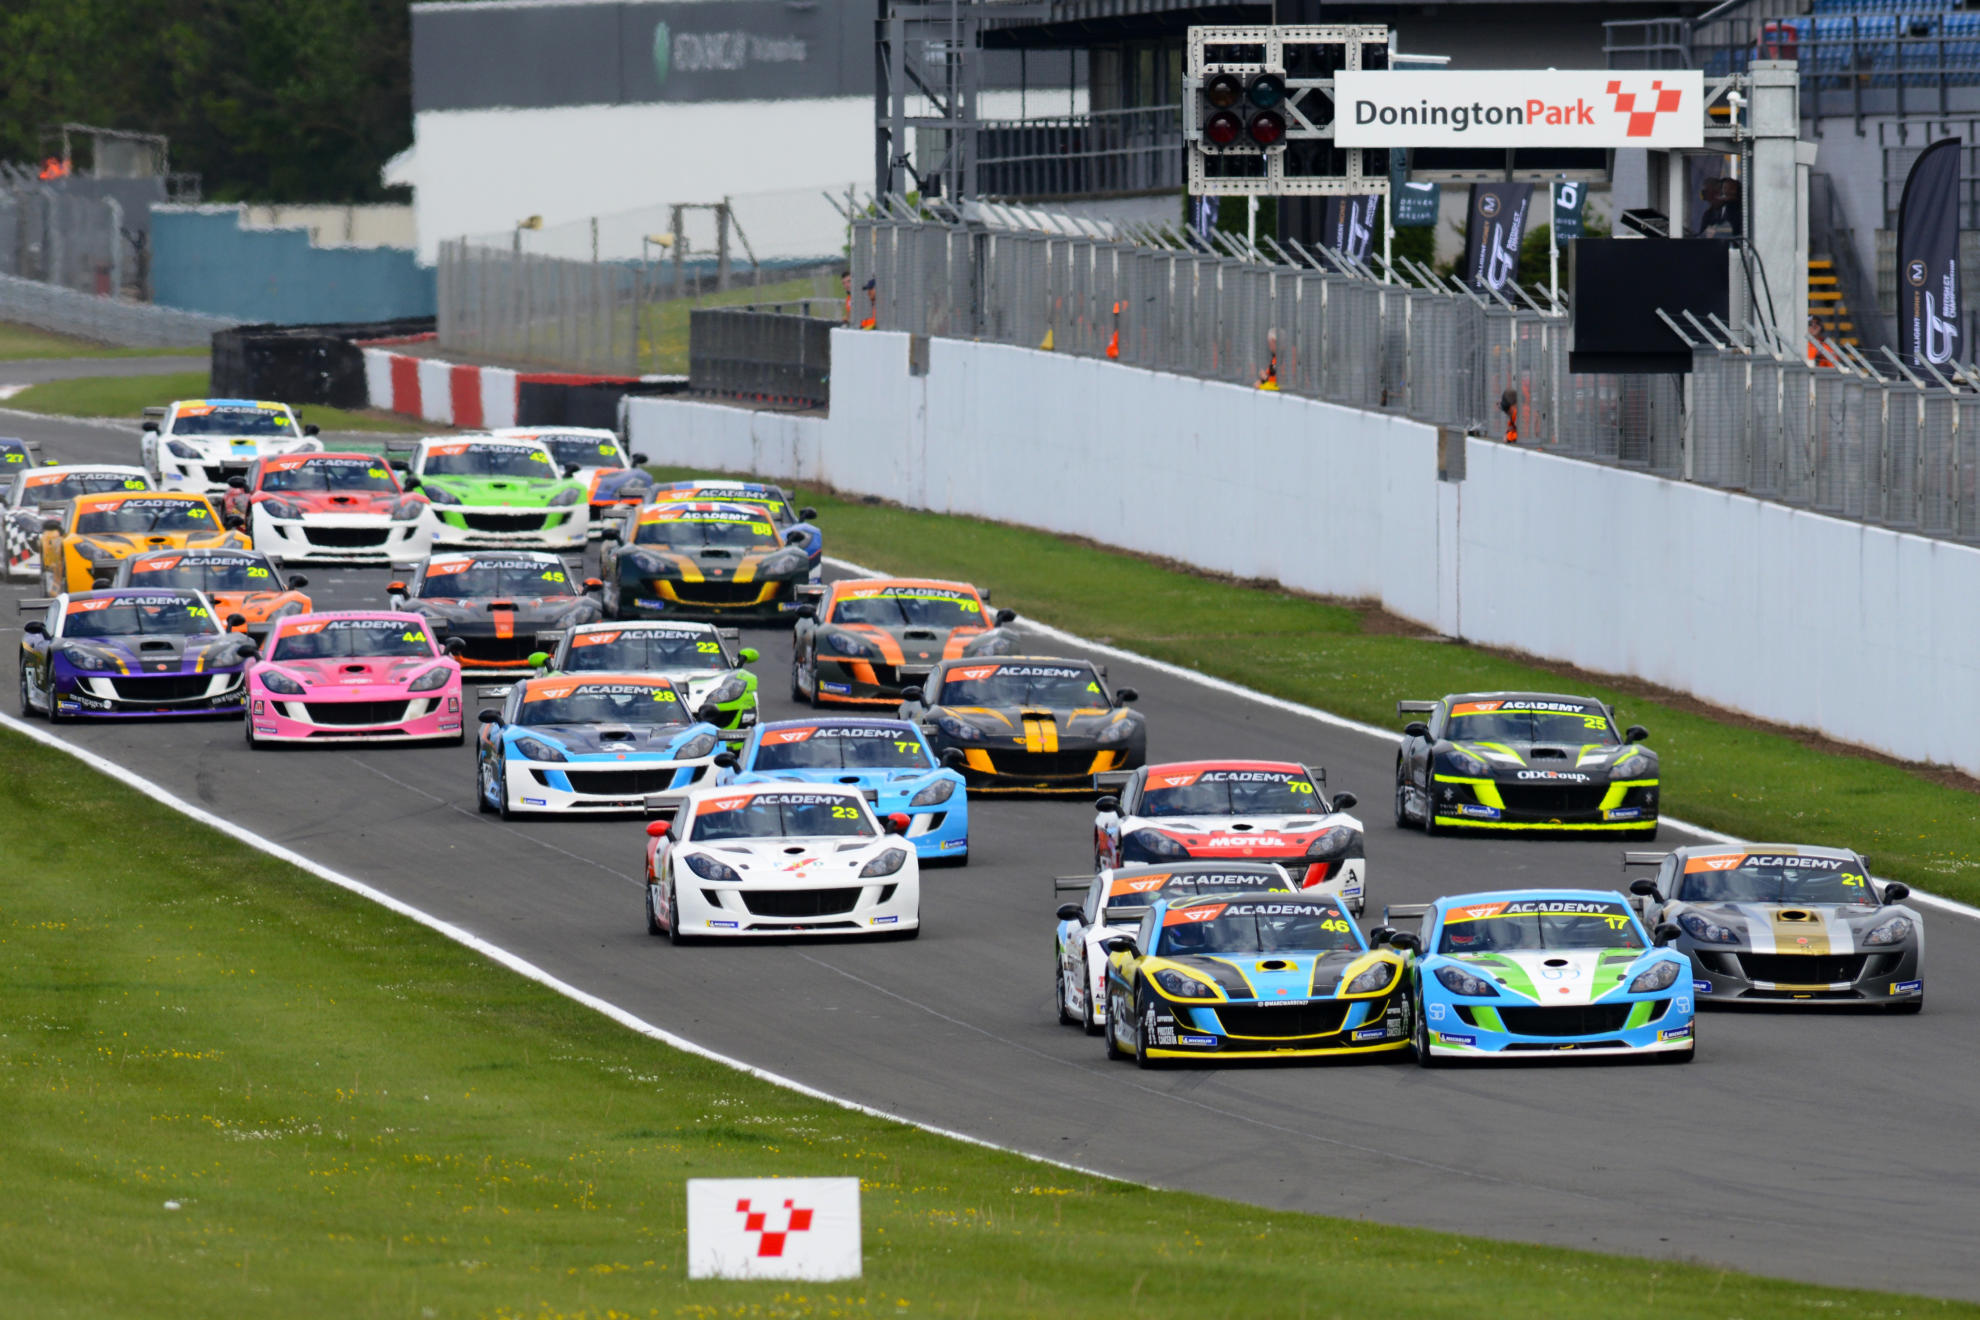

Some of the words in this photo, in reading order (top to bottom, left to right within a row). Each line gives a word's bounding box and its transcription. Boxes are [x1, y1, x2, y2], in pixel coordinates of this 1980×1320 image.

[214, 405, 278, 417] ACADEMY
[539, 435, 602, 445] ACADEMY
[469, 445, 535, 454] ACADEMY
[305, 459, 374, 468] ACADEMY
[66, 472, 136, 482] ACADEMY
[699, 490, 768, 499] ACADEMY
[123, 500, 195, 509] ACADEMY
[187, 508, 207, 519] 47
[680, 512, 750, 521] ACADEMY
[178, 556, 256, 567] ACADEMY
[472, 560, 549, 570] ACADEMY
[247, 567, 268, 578] 20
[883, 587, 961, 599] ACADEMY
[113, 596, 191, 606] ACADEMY
[187, 606, 208, 618] 74
[327, 620, 408, 630] ACADEMY
[402, 631, 427, 642] 44
[620, 631, 701, 640] ACADEMY
[696, 642, 720, 654] 22
[996, 667, 1081, 678] ACADEMY
[576, 685, 661, 696] ACADEMY
[1086, 681, 1100, 694] 4
[652, 690, 677, 703] 28
[1502, 701, 1584, 713] ACADEMY
[1583, 717, 1607, 730] 25
[813, 728, 904, 739] ACADEMY
[894, 741, 921, 754] 77
[1200, 772, 1294, 783] ACADEMY
[1287, 780, 1313, 794] 70
[752, 795, 845, 805] ACADEMY
[831, 806, 859, 819] 23
[1208, 836, 1285, 847] MOTUL
[1745, 856, 1843, 870] ACADEMY
[1169, 875, 1269, 886] ACADEMY
[1841, 872, 1865, 888] 21
[1224, 904, 1326, 916] ACADEMY
[1506, 902, 1610, 914] ACADEMY
[1320, 919, 1351, 933] 46
[1604, 917, 1629, 930] 17
